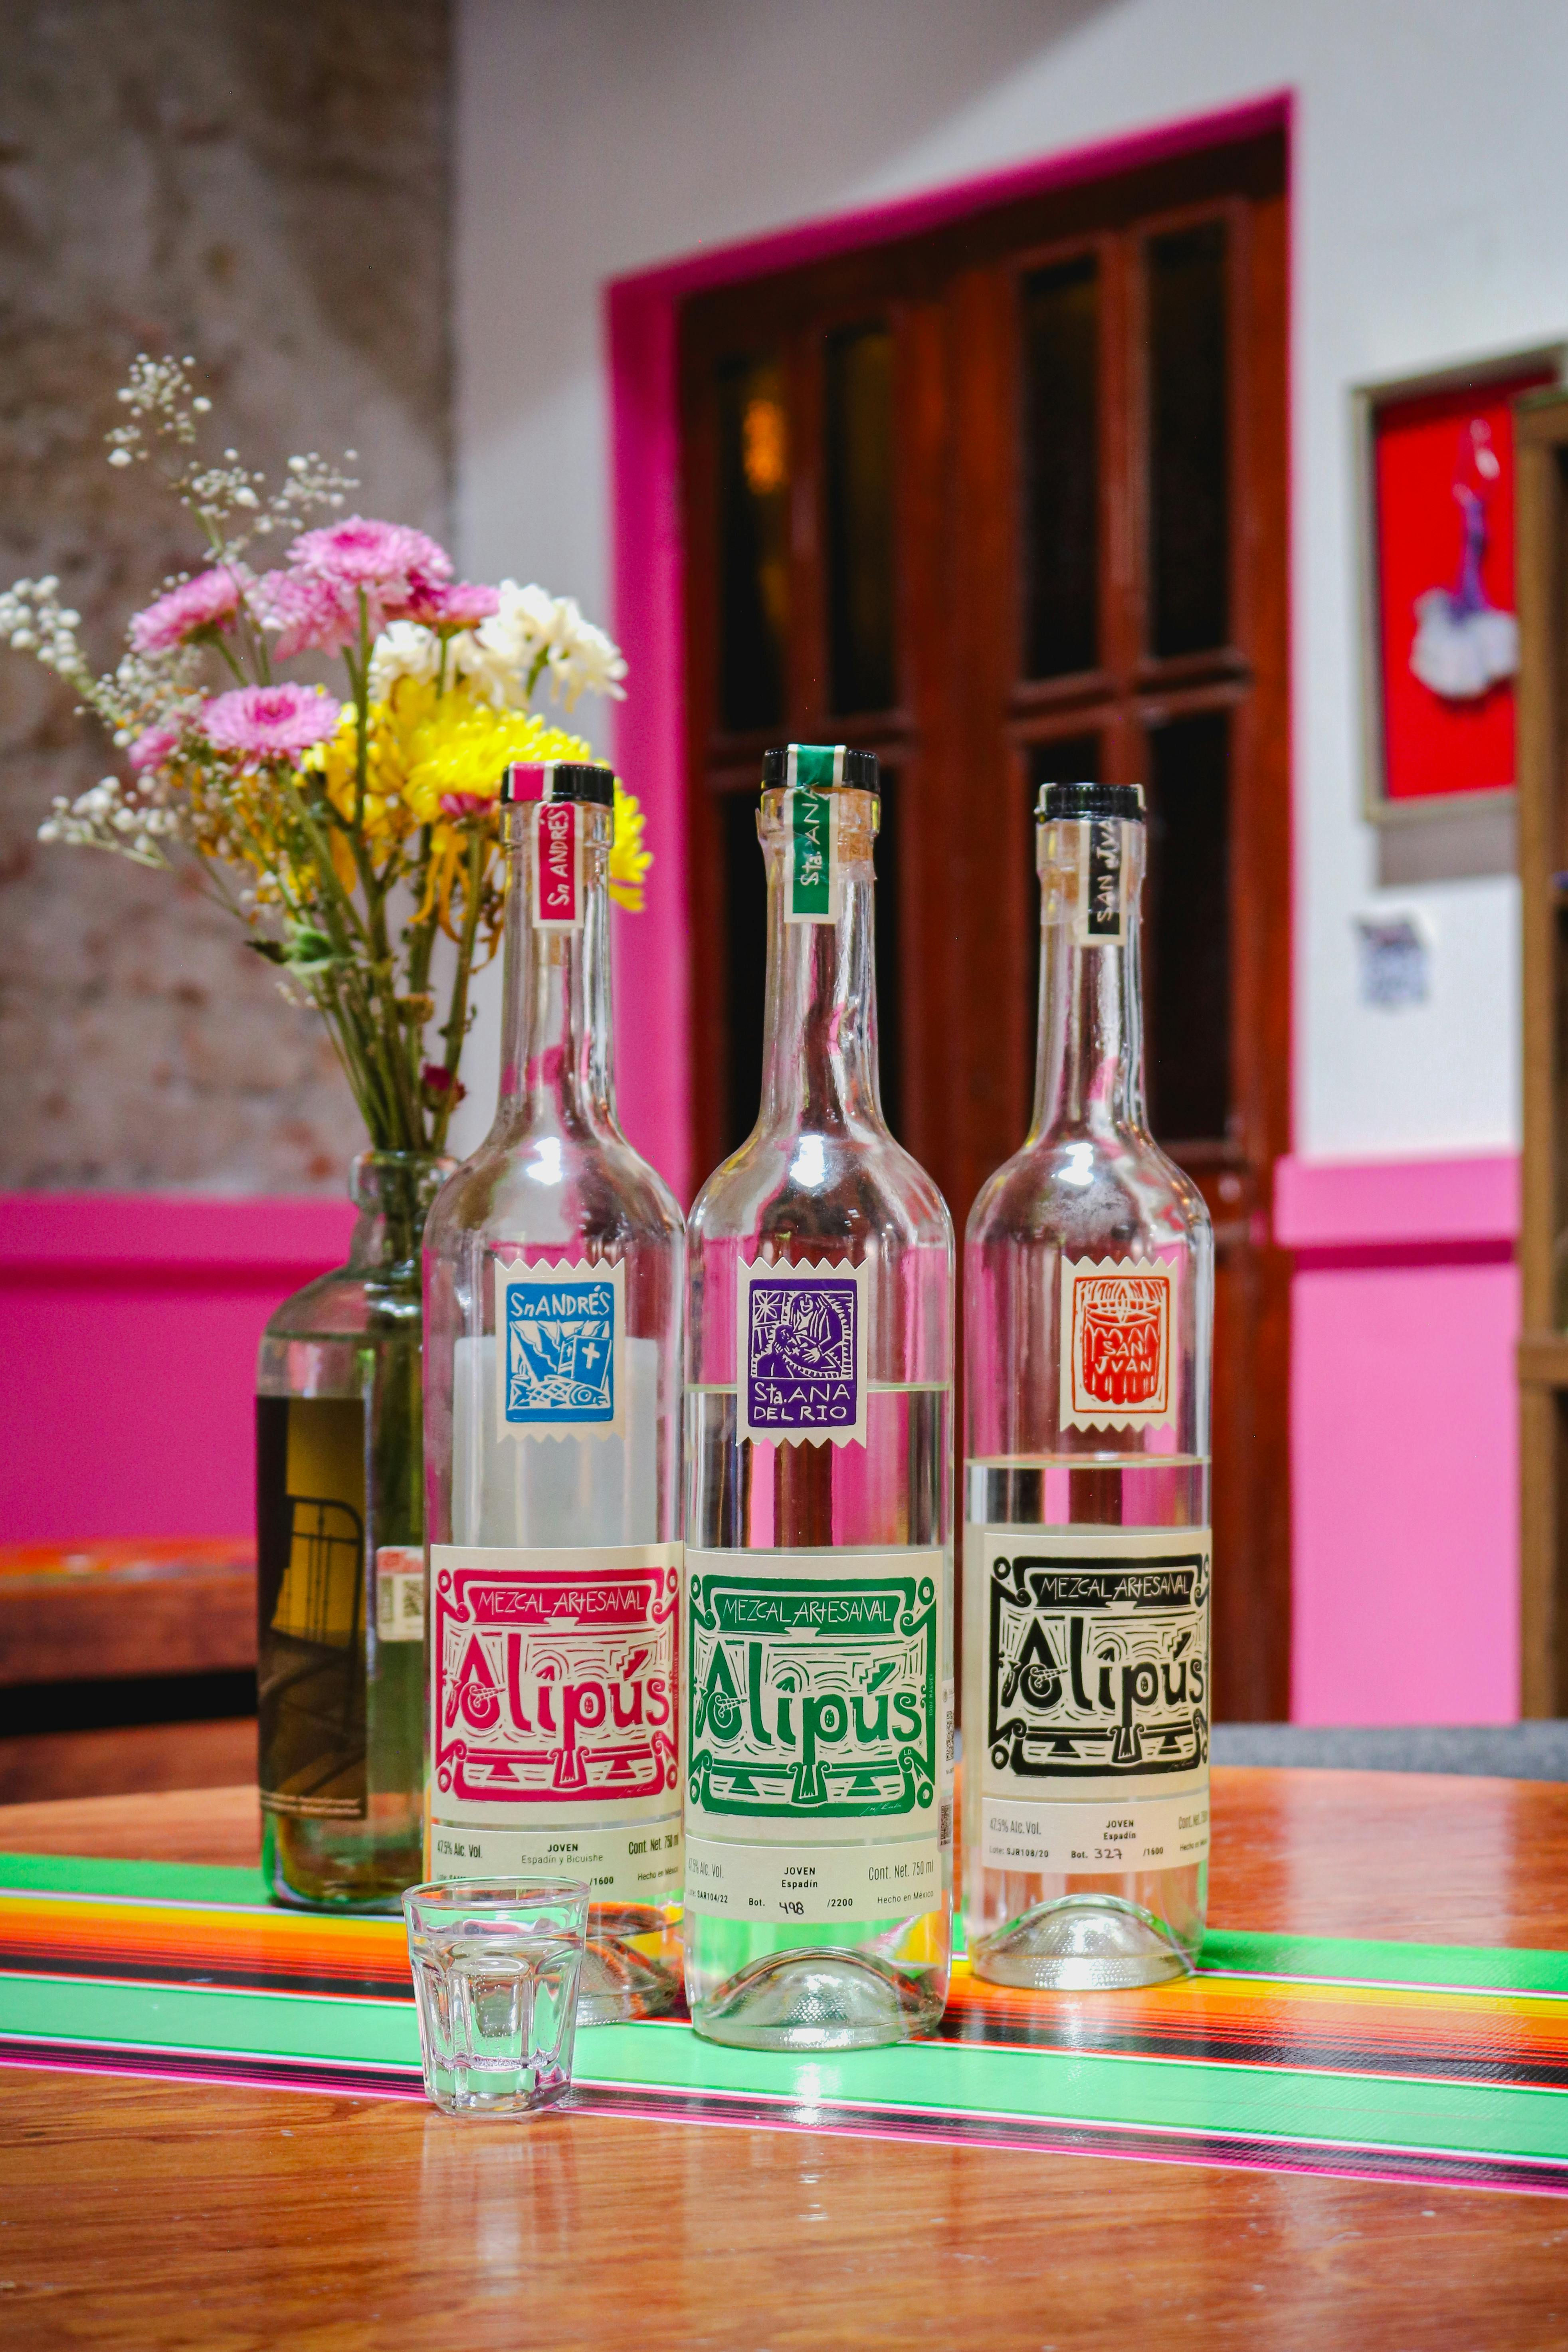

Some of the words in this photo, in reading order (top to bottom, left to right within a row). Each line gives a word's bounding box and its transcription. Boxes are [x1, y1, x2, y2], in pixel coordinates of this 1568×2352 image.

[546, 883, 570, 907] Sn
[1097, 875, 1114, 923] SAN
[1103, 1340, 1144, 1357] SAN
[754, 1406, 794, 1421] DEL
[800, 1405, 847, 1421] RIO
[1039, 1576, 1113, 1600] MEZCAL
[1112, 1573, 1190, 1601] ARTESANAL
[478, 1589, 551, 1616] MEZCAL
[551, 1586, 645, 1617] ARTESANAL
[723, 1598, 792, 1623] MEZCAL
[792, 1598, 893, 1627] ARTESANAL
[1001, 1616, 1205, 1727] Alipús
[445, 1633, 671, 1752] Alipús
[695, 1640, 922, 1766] Alipús
[1010, 1820, 1025, 1834] Alc.
[1026, 1821, 1042, 1835] Vol.
[1106, 1819, 1134, 1828] JOVEN
[1103, 1831, 1136, 1841] Espadín
[547, 1843, 578, 1852] JOVEN
[1094, 1848, 1123, 1860] 327
[1142, 1847, 1164, 1856] /1600
[521, 1855, 556, 1865] Espadín
[559, 1857, 564, 1865] y
[566, 1854, 604, 1864] Bicuishe
[637, 1871, 657, 1881] Hecho
[711, 1863, 724, 1879] Vol.
[784, 1867, 816, 1875] JOVEN
[868, 1865, 891, 1881] Cont.
[894, 1863, 910, 1878] Net.
[913, 1861, 924, 1876] 750
[925, 1859, 934, 1874] ml
[589, 1876, 614, 1887] /1600
[782, 1879, 818, 1890] Espadín
[697, 1890, 728, 1903] SAR104/22
[877, 1895, 901, 1904] Hecho
[913, 1890, 934, 1900] México
[748, 1898, 765, 1907] Bot.
[779, 1901, 804, 1915] 498
[827, 1898, 853, 1908] /2200
